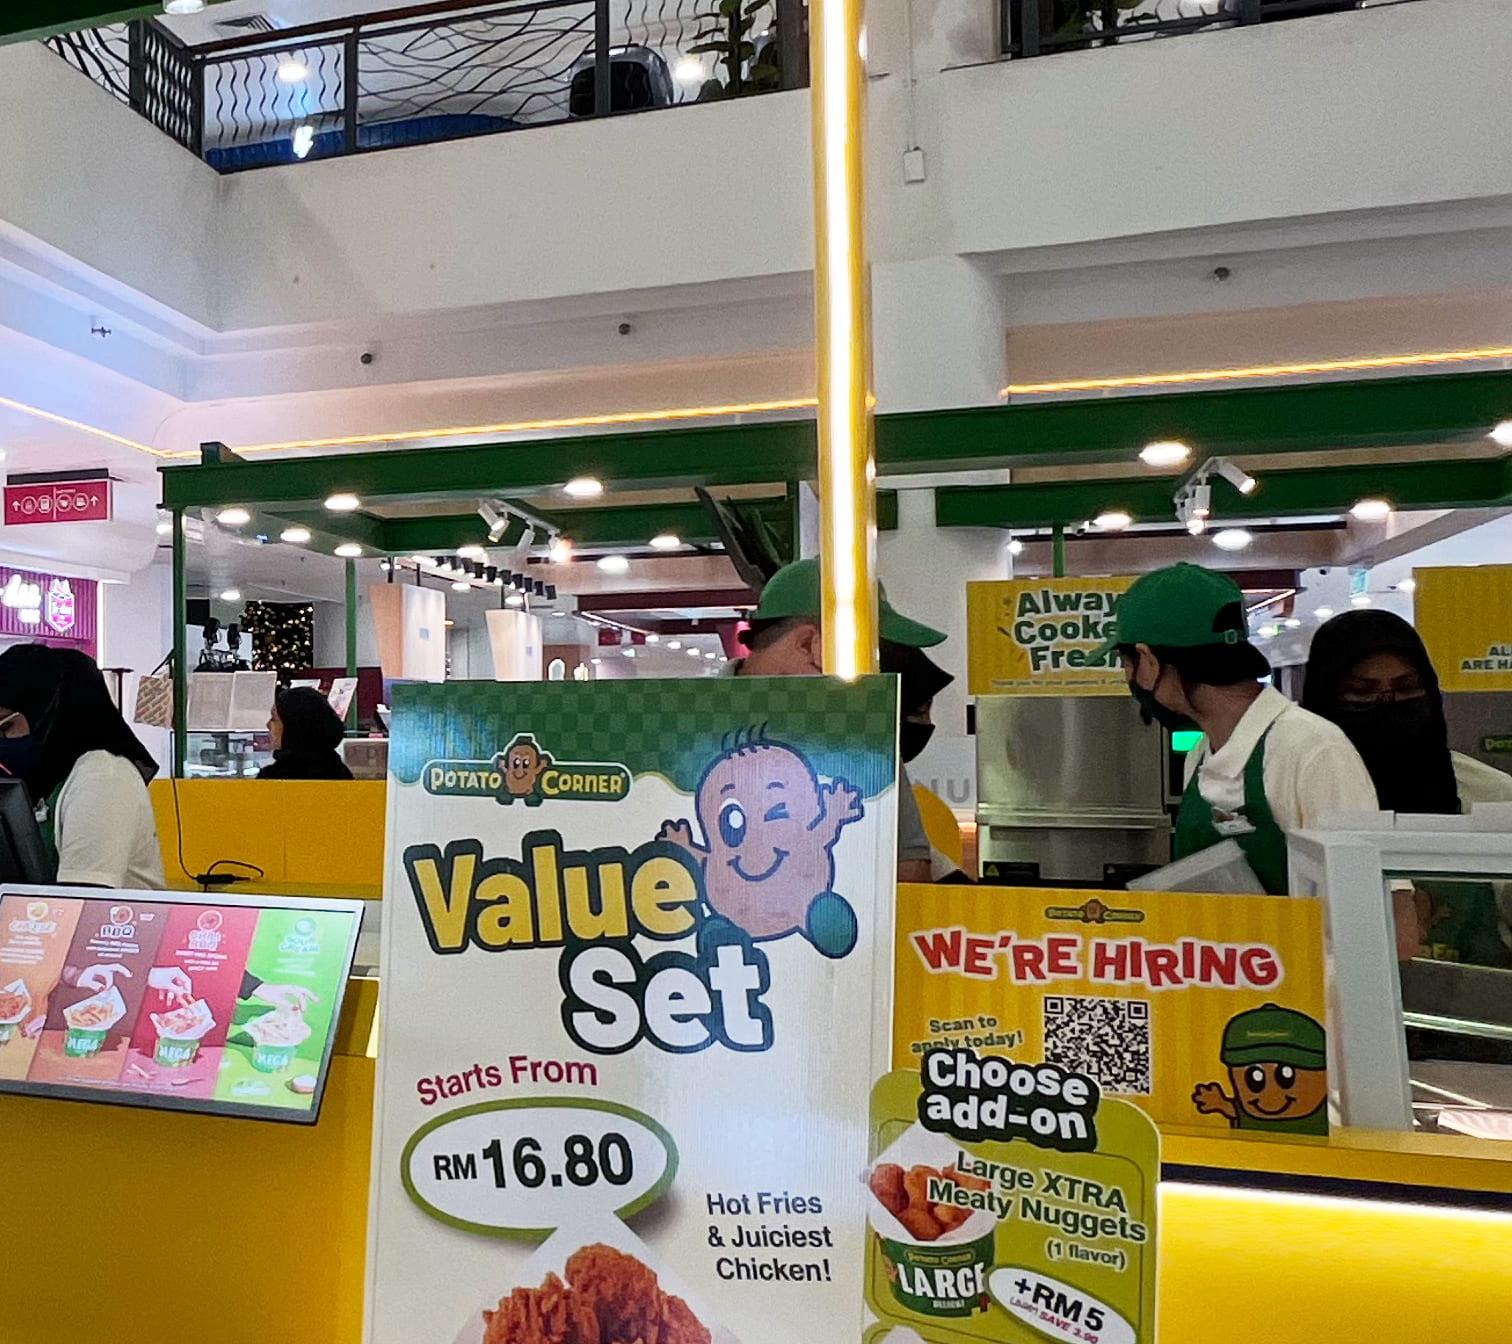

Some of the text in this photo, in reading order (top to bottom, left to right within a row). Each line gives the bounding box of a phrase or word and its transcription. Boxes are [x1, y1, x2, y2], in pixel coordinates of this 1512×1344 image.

[1017, 590, 1121, 617] Alway
[1015, 614, 1118, 645] Cooke
[430, 768, 625, 795] POTATO CORNER
[410, 840, 700, 952] Value
[101, 925, 135, 937] BBQ
[914, 930, 1278, 987] WE'RE HIRING
[566, 943, 768, 1051] Set
[930, 1015, 998, 1033] Scan to
[912, 1030, 1024, 1052] apply today!
[417, 1056, 598, 1107] Starts From
[928, 1052, 1089, 1106] Choose
[926, 1094, 1089, 1140] add-on
[958, 1151, 1127, 1213] Large XTRA
[706, 1192, 823, 1217] Hot Fries
[929, 1179, 1147, 1242] Meaty Nuggets
[707, 1224, 833, 1249] & Juiciest
[716, 1258, 832, 1284] Chicken!
[896, 1262, 986, 1298] LARGE
[1040, 1311, 1072, 1332] SAVE
